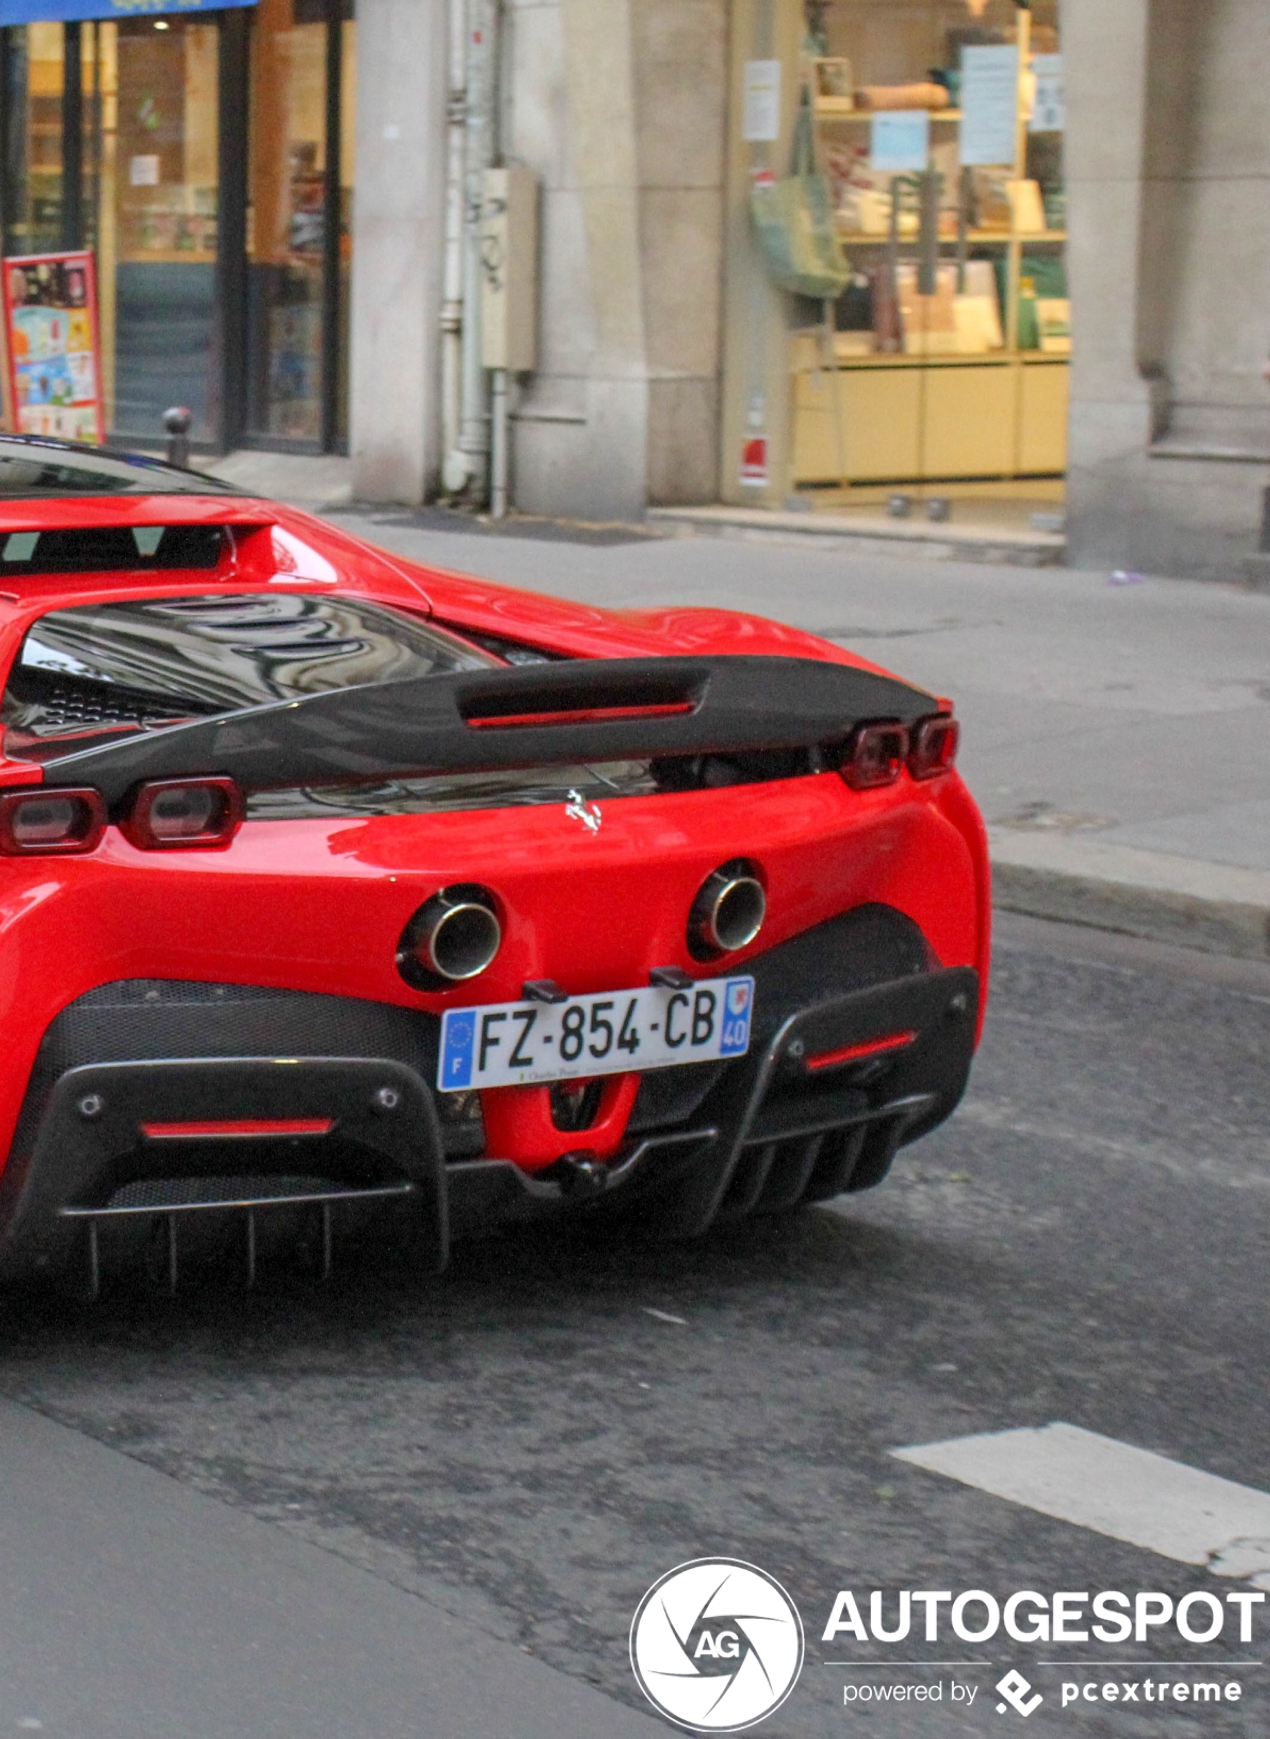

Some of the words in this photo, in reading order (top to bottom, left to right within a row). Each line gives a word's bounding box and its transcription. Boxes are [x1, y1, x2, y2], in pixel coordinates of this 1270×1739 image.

[478, 989, 718, 1072] FZ-854-CB
[723, 1020, 747, 1047] 40
[450, 1057, 463, 1075] F
